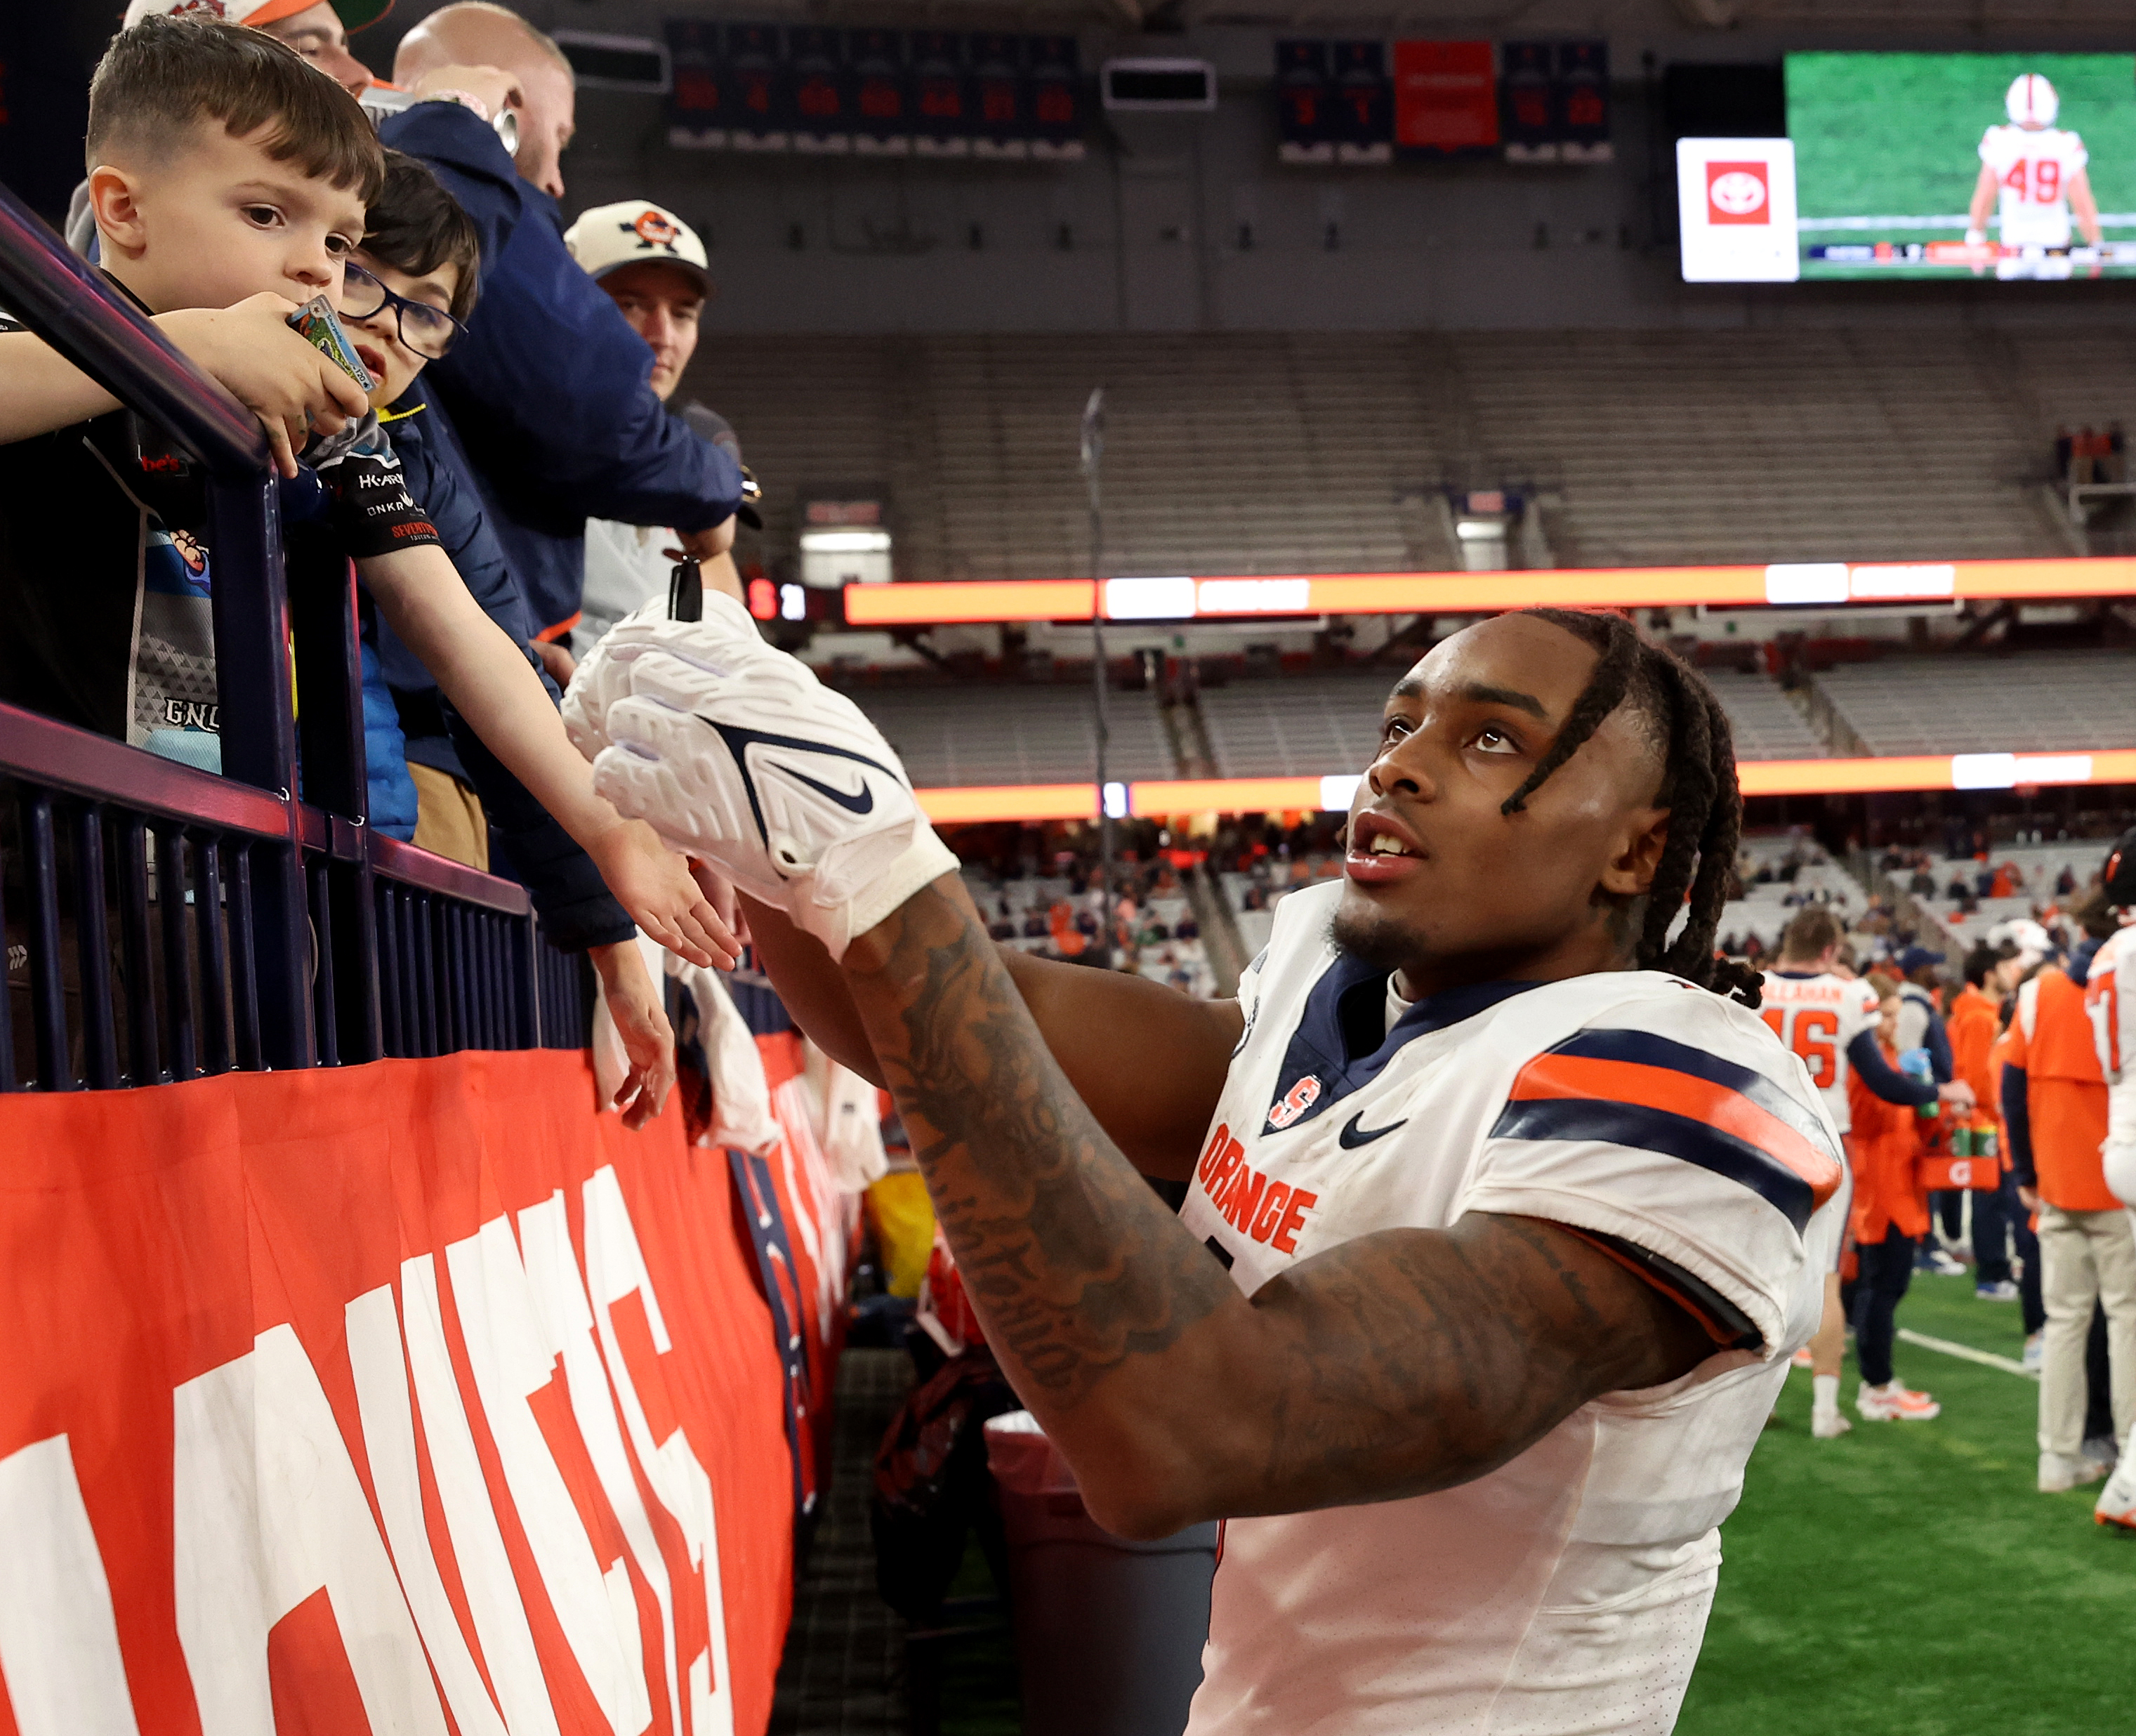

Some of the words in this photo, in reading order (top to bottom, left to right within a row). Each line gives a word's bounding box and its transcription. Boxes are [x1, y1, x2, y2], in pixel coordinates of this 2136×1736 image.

[2004, 159, 2059, 204] 49
[355, 369, 366, 381] 120
[1199, 1122, 1319, 1255] ORANGE
[1949, 1160, 1972, 1186] G
